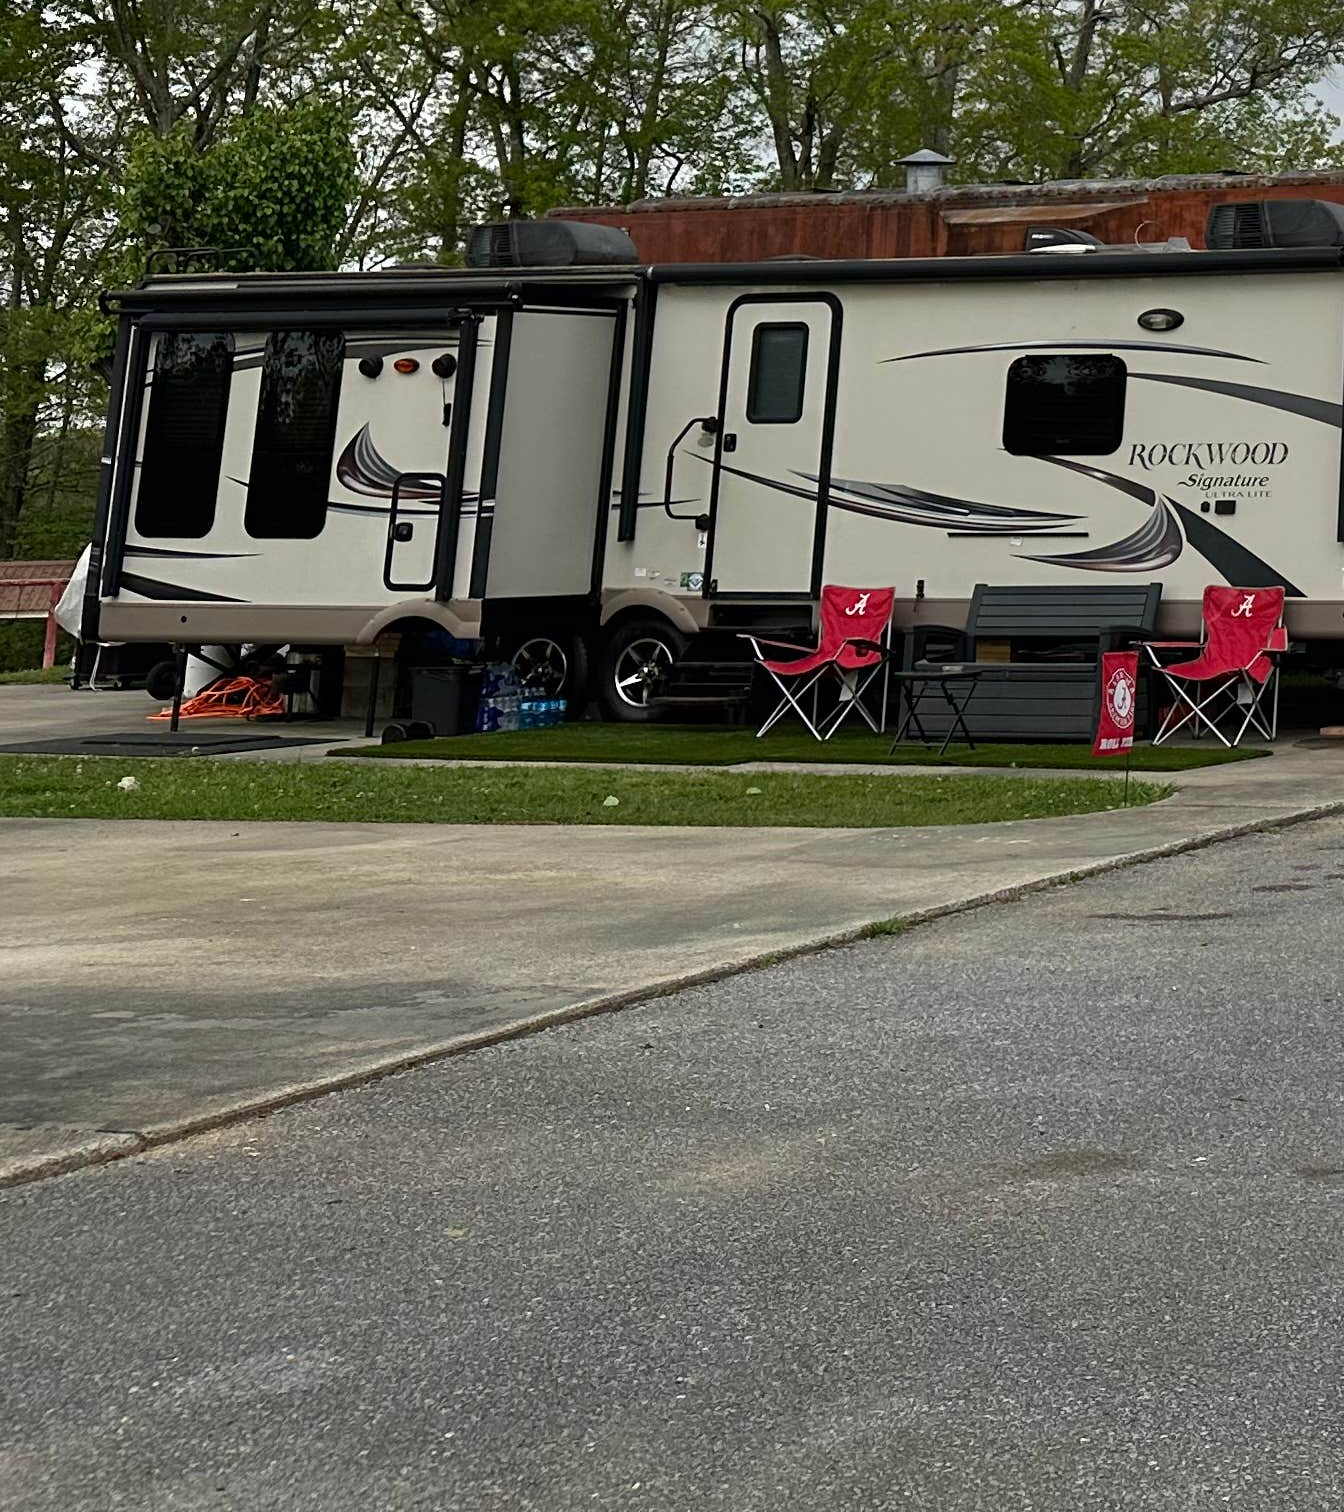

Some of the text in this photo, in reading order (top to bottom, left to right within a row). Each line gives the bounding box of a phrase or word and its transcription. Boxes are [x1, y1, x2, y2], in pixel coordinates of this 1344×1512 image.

[1128, 442, 1289, 471] ROCKWOOD
[1178, 473, 1270, 490] Signature
[1205, 490, 1273, 499] ULTRA LITE
[845, 593, 870, 616] A
[1231, 594, 1256, 617] A
